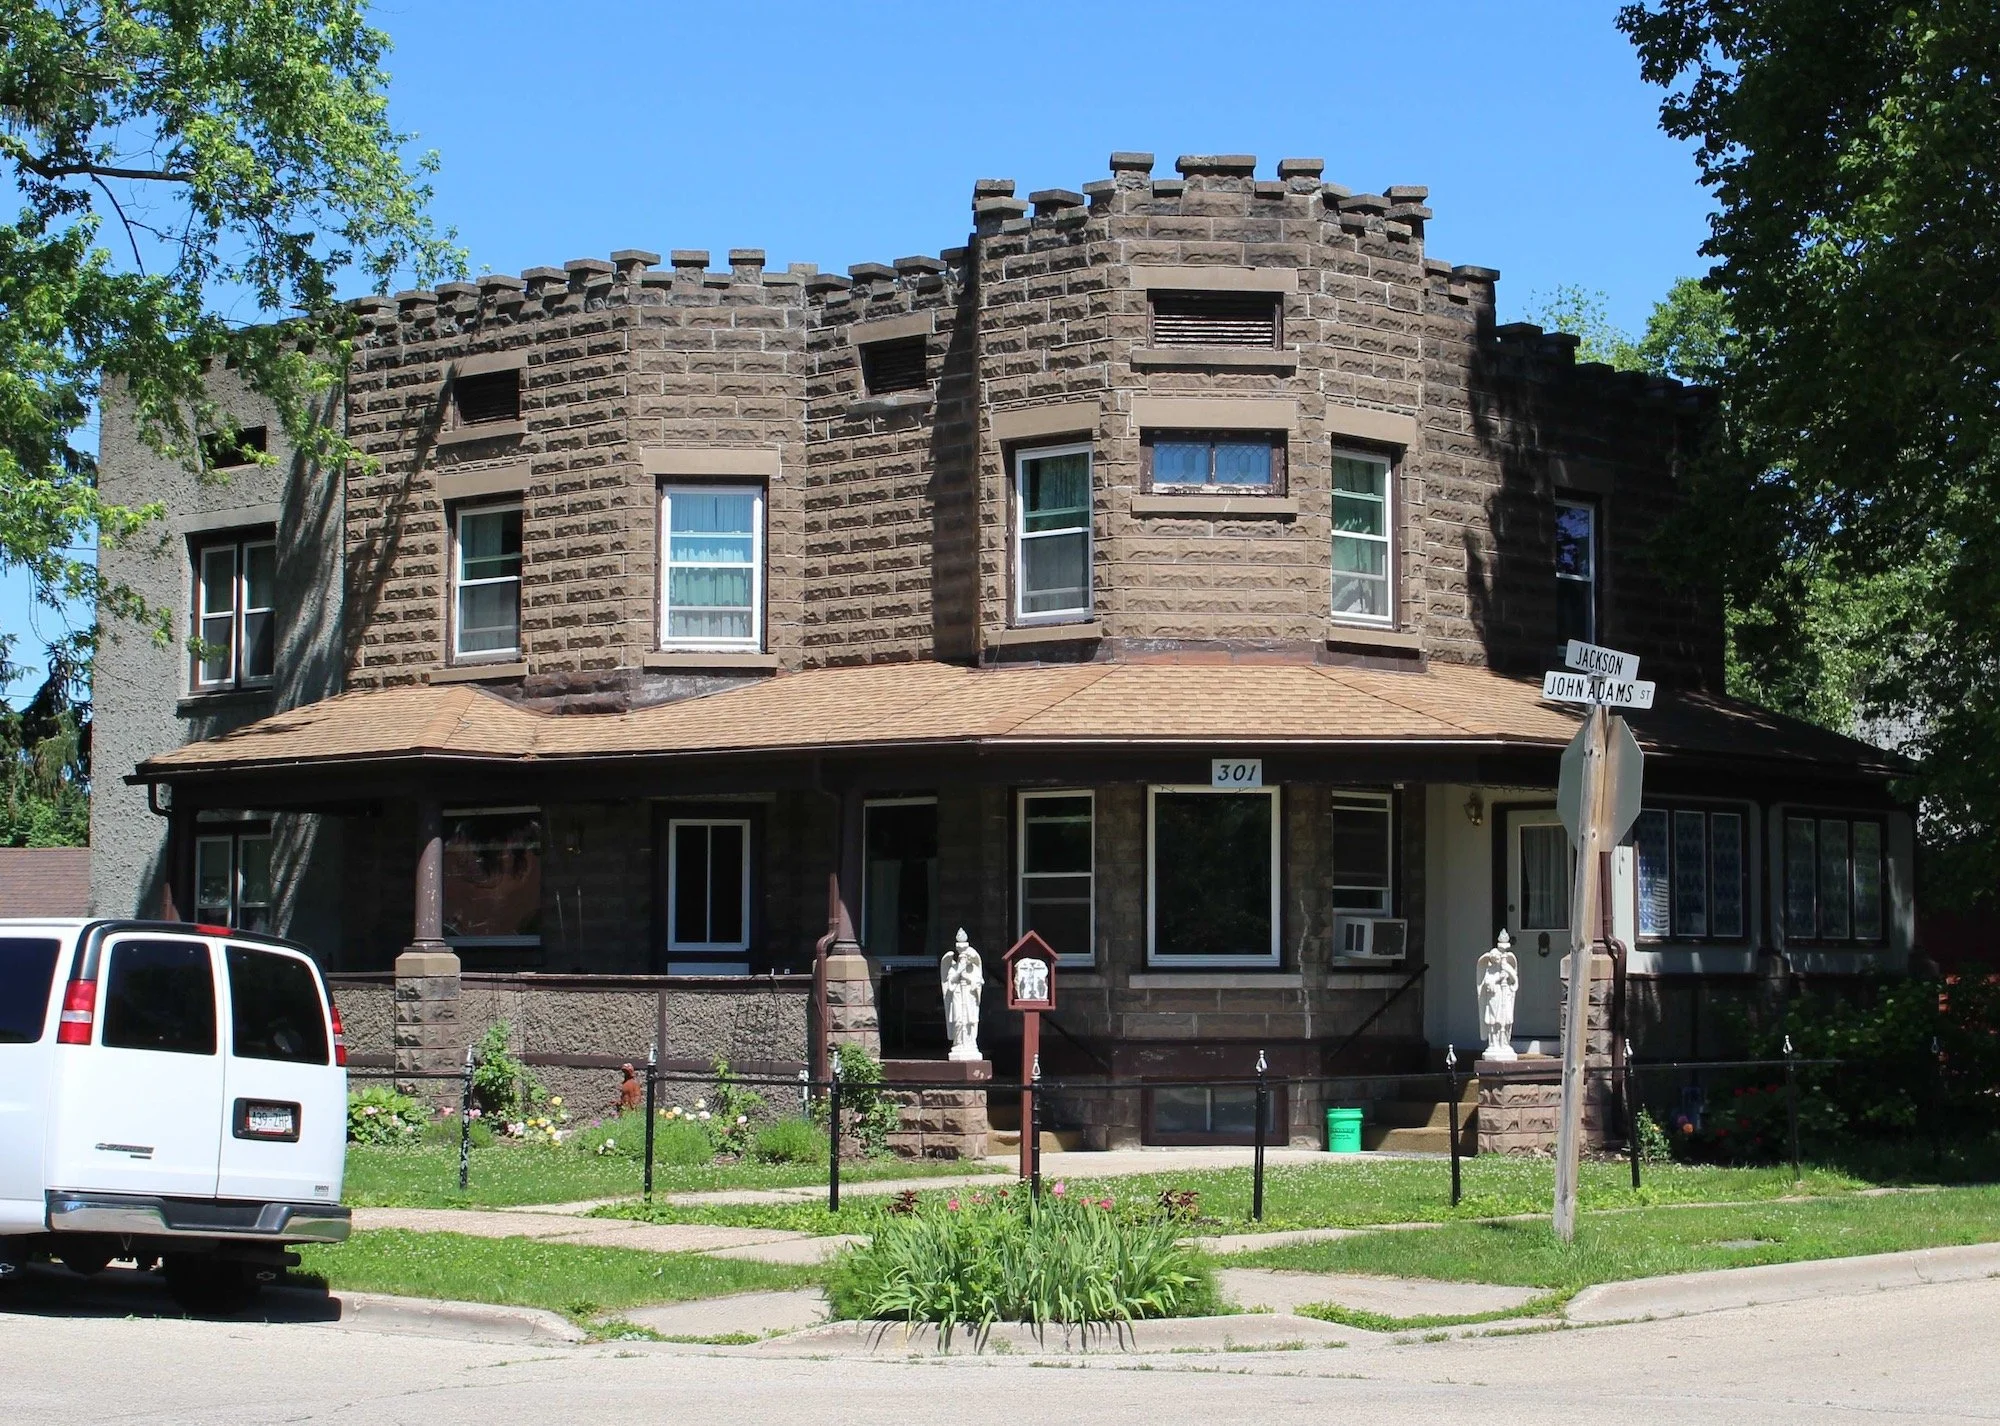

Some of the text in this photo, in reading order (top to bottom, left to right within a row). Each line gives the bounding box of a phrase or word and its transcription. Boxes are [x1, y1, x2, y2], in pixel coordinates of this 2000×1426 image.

[1576, 647, 1624, 676] JACKSON
[1547, 677, 1652, 703] JOHN ADAMS ST
[1217, 764, 1256, 781] 301
